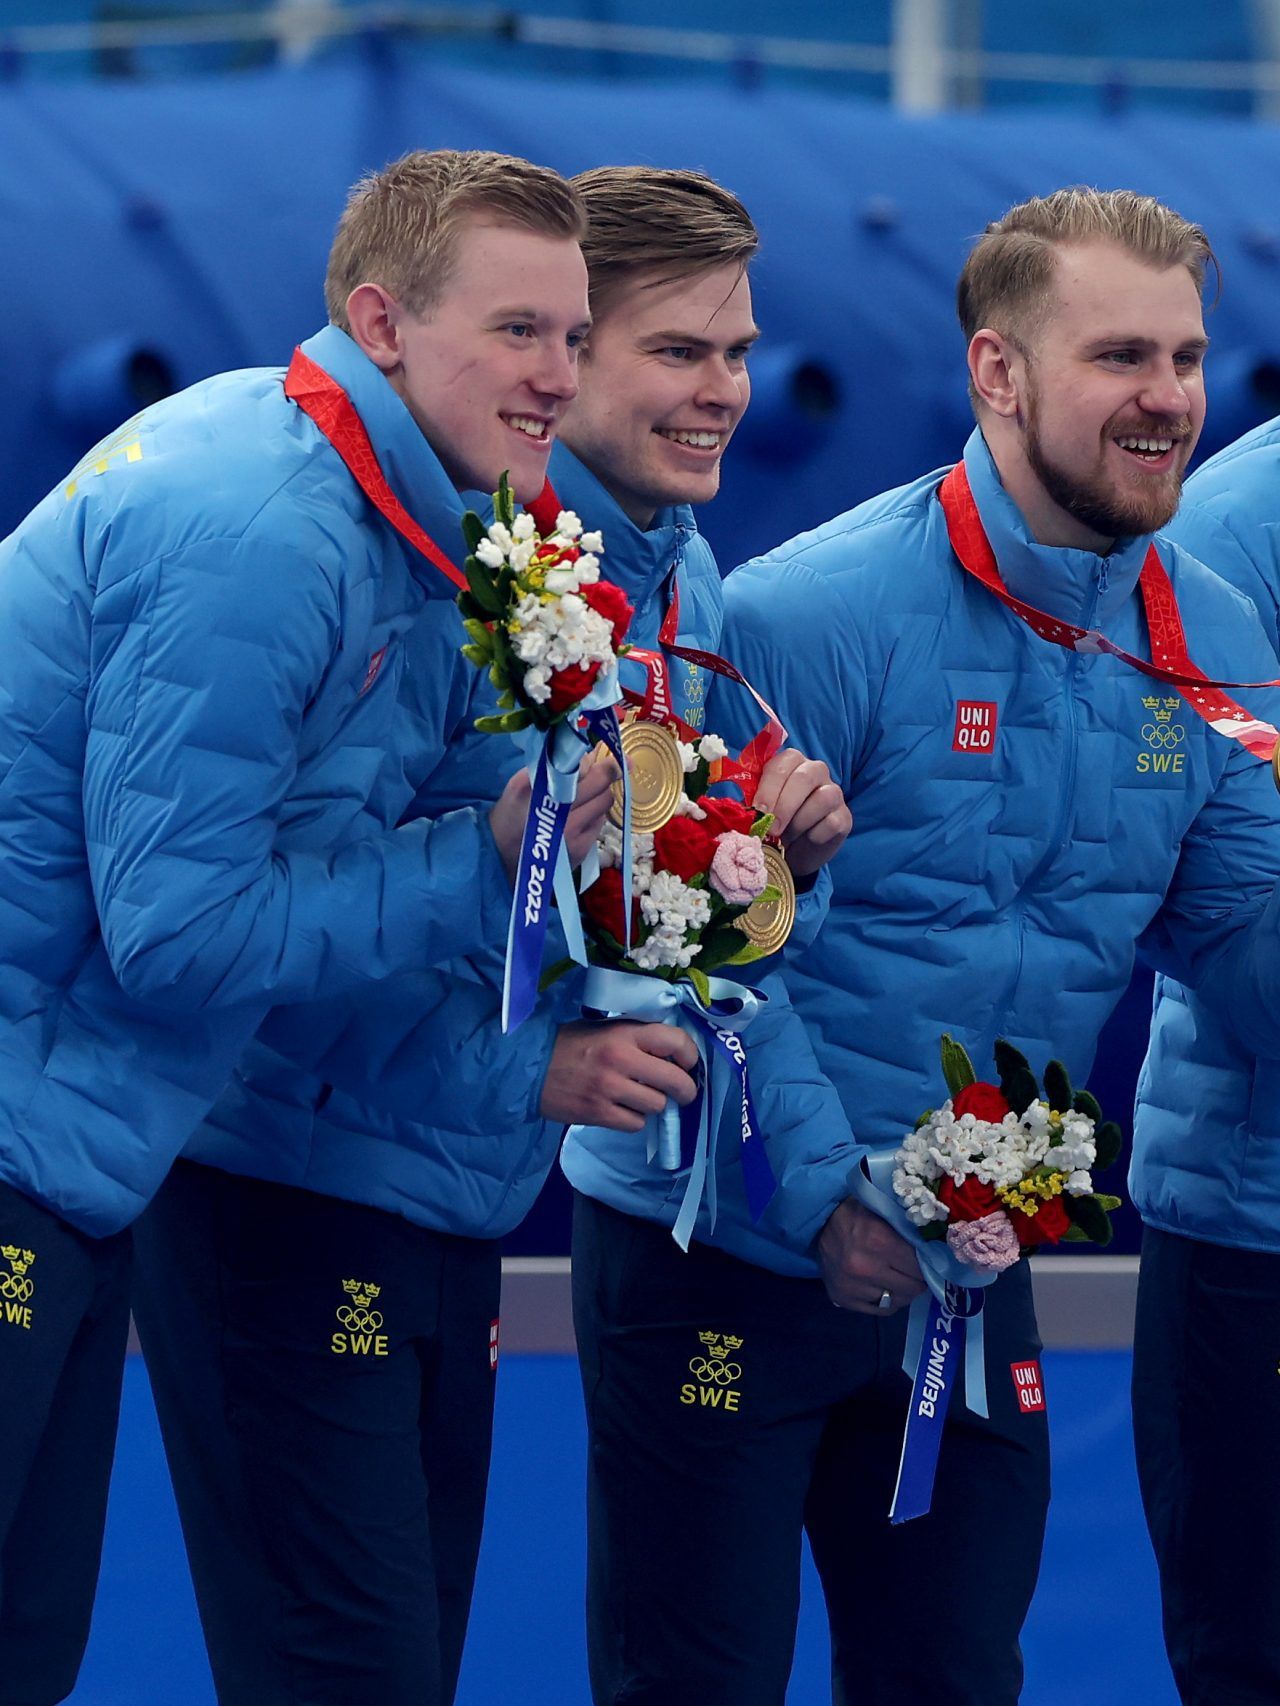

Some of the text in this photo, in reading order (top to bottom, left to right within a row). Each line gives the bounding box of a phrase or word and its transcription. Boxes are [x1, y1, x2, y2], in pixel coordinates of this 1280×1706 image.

[960, 707, 989, 725] UNI
[957, 728, 990, 749] QLO
[1136, 752, 1185, 773] SWE
[524, 795, 560, 928] EIJING 2022
[707, 1020, 746, 1065] 202
[331, 1332, 389, 1356] SWE
[918, 1337, 950, 1419] BEIJING
[1015, 1367, 1037, 1386] UNI
[680, 1383, 741, 1412] SWE
[1020, 1387, 1042, 1409] QLO
